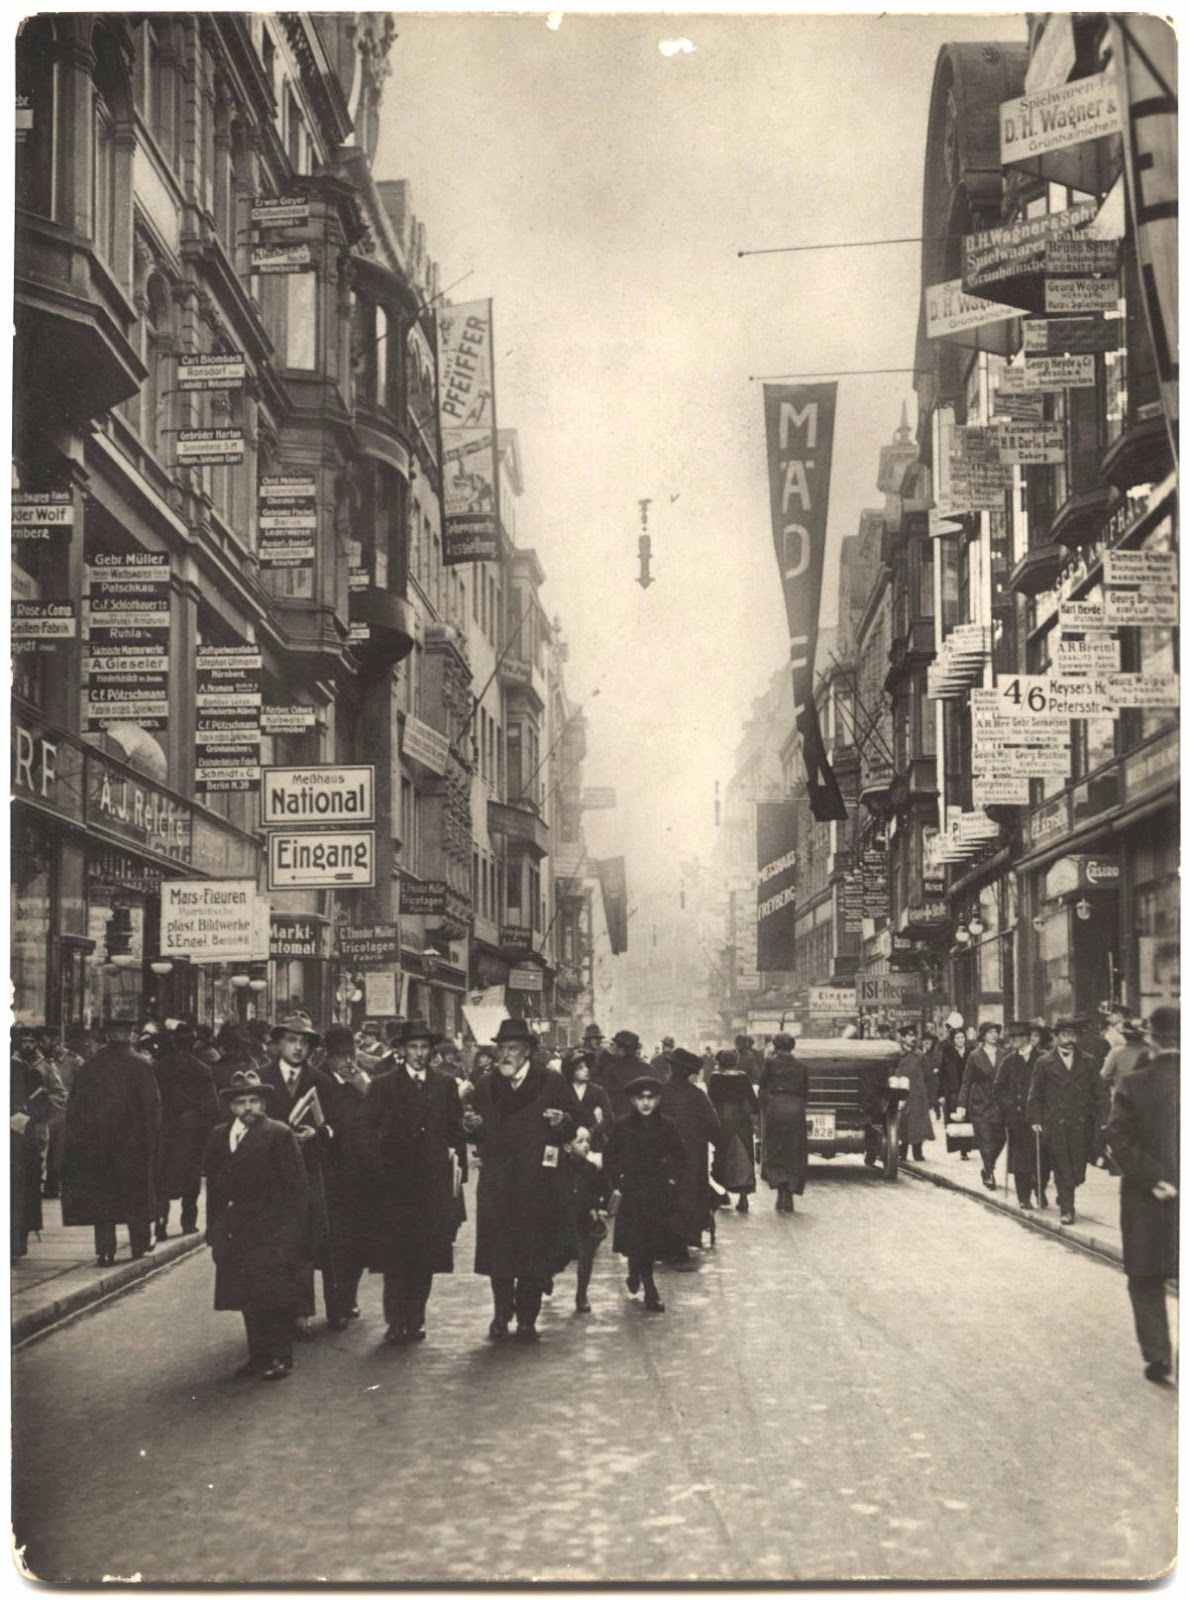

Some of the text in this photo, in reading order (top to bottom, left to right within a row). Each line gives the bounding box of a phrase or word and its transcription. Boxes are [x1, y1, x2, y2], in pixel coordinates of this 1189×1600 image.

[1040, 100, 1103, 133] Wagner
[442, 315, 488, 420] PFEIFFER
[36, 507, 66, 521] Wolf
[126, 553, 165, 565] Müller
[16, 603, 41, 617] Rose
[109, 628, 143, 639] Ruhla
[201, 769, 239, 779] Schmidt
[292, 773, 346, 785] Meßhaus
[272, 784, 365, 815] National
[278, 839, 368, 871] Eingang
[198, 918, 250, 931] Bildwerke
[270, 941, 316, 955] utomat
[340, 941, 396, 953] Tricotagen
